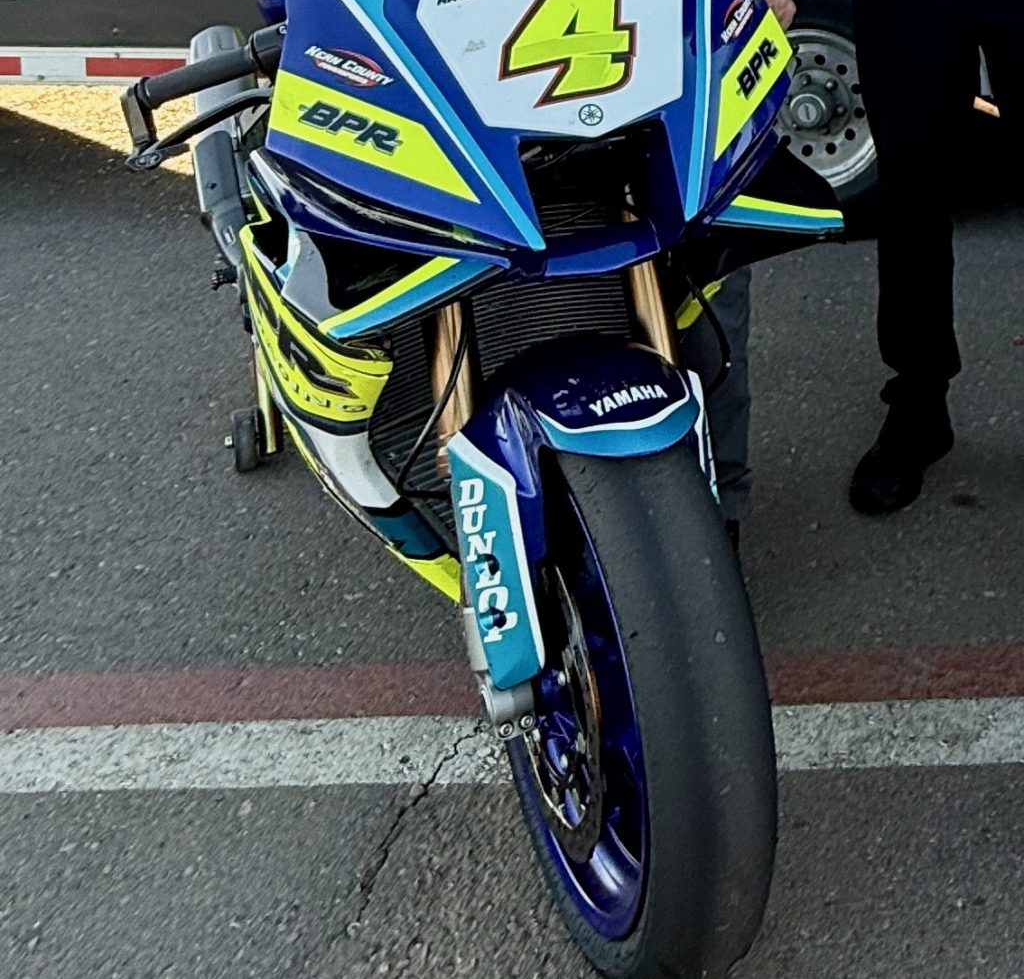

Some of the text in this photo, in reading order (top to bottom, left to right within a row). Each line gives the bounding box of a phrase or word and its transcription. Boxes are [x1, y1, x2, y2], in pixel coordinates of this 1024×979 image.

[736, 37, 779, 101] BPR
[298, 99, 404, 156] BPR
[588, 383, 669, 417] YAMAHA
